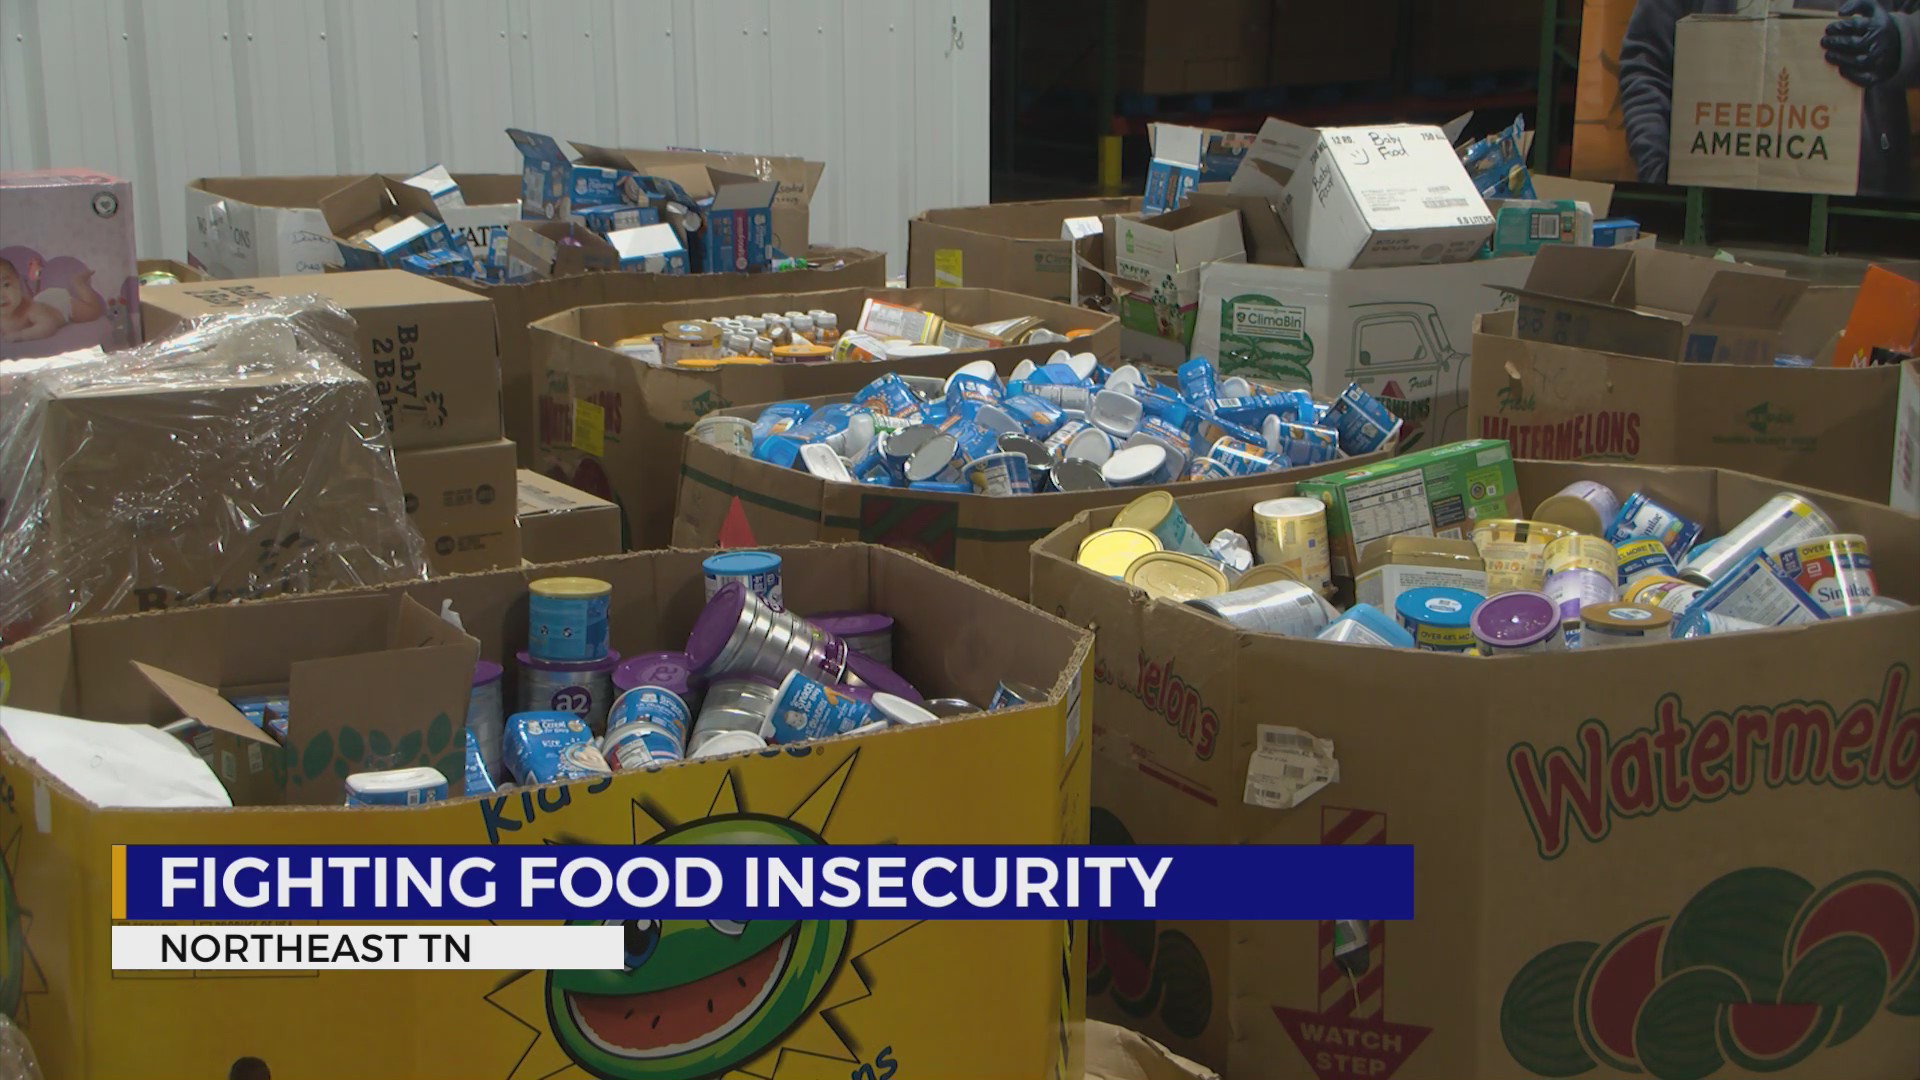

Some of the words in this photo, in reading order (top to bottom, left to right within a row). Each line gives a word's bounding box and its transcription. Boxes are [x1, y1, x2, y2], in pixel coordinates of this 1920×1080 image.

[1694, 101, 1831, 133] FEEDING
[1368, 132, 1402, 149] Baby
[1377, 143, 1410, 161] Food
[1690, 131, 1829, 161] AMERICA
[1312, 164, 1333, 193] Baby
[1247, 312, 1301, 329] ClimaBin
[372, 337, 395, 355] 2
[396, 323, 422, 399] Baby
[1481, 410, 1641, 462] WATERMELONS
[1421, 631, 1442, 640] OVER
[555, 693, 589, 713] a2
[1507, 662, 1920, 860] Watermelo
[1299, 1021, 1403, 1055] WATCH
[1315, 1051, 1386, 1076] STEP
